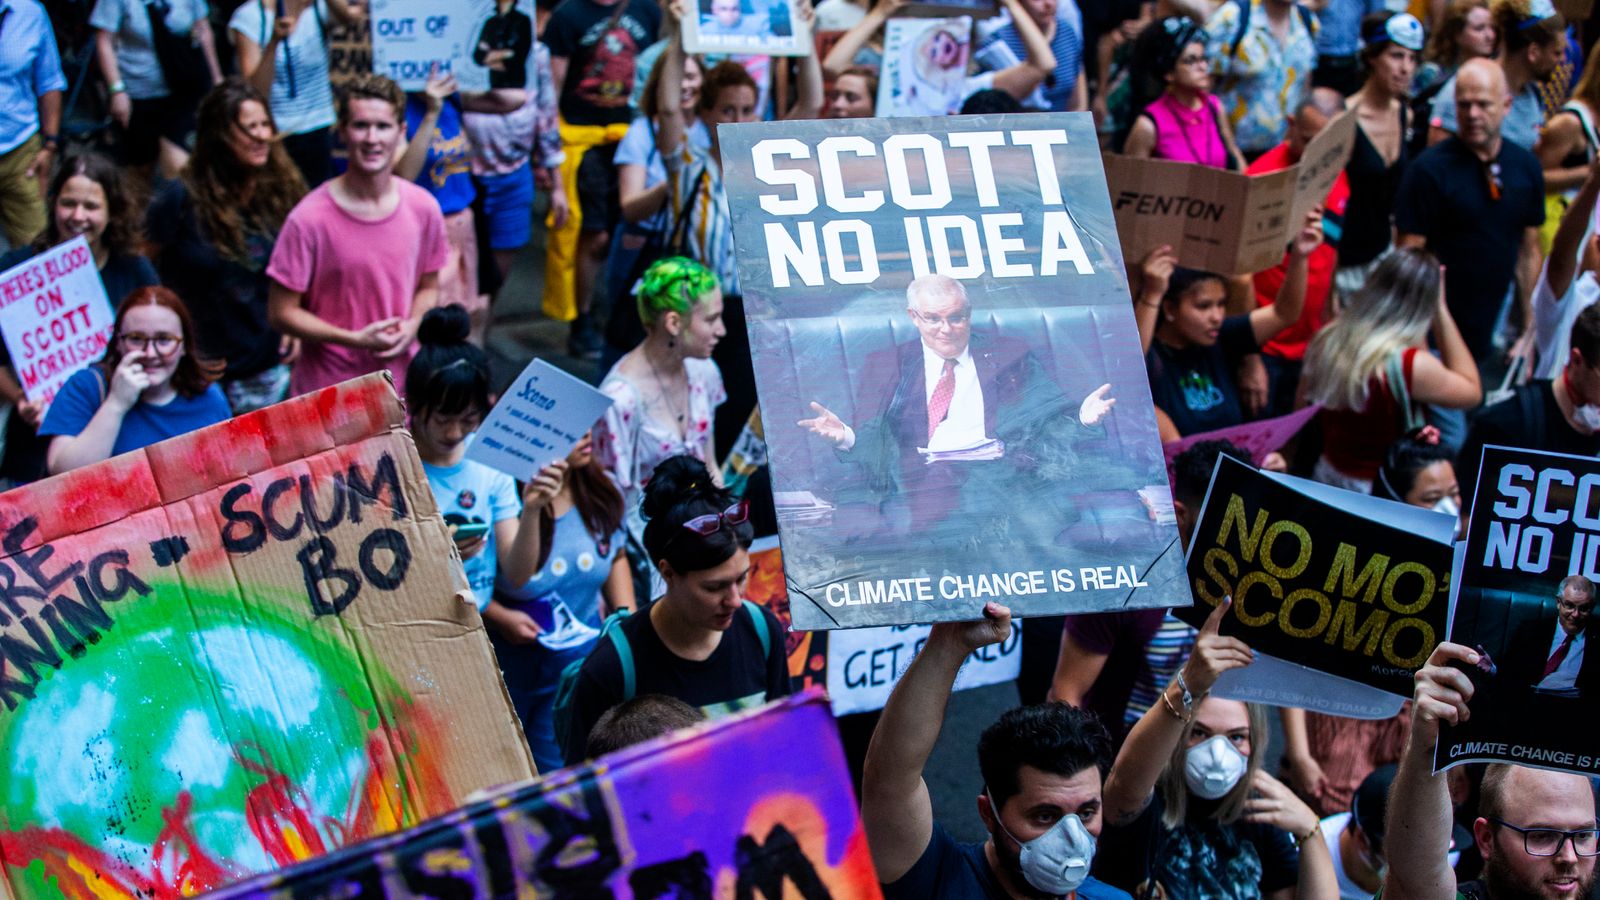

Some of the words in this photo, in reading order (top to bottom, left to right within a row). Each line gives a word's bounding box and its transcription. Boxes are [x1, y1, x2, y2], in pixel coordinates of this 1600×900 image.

[377, 17, 416, 37] OUT
[425, 15, 449, 33] OF
[751, 129, 1068, 215] SCOTT
[1115, 190, 1225, 223] FENTON
[44, 246, 90, 283] BLOOD
[764, 219, 881, 288] NO
[903, 211, 1095, 280] IDEA
[35, 285, 64, 316] ON
[21, 303, 92, 359] SCOTT
[220, 450, 408, 553] SCUM
[1216, 492, 1312, 579] NO
[1483, 520, 1554, 574] NO
[0, 514, 84, 627] RE
[297, 527, 412, 618] BO
[825, 577, 934, 608] CLIMATE
[939, 570, 1047, 600] CHANGE
[1052, 568, 1075, 592] IS
[1080, 564, 1148, 591] REAL
[1196, 547, 1436, 669] SCOMO
[844, 643, 904, 689] GET
[1450, 741, 1509, 758] CLIMATE
[1511, 745, 1576, 766] CHANGE
[1576, 755, 1592, 768] IS
